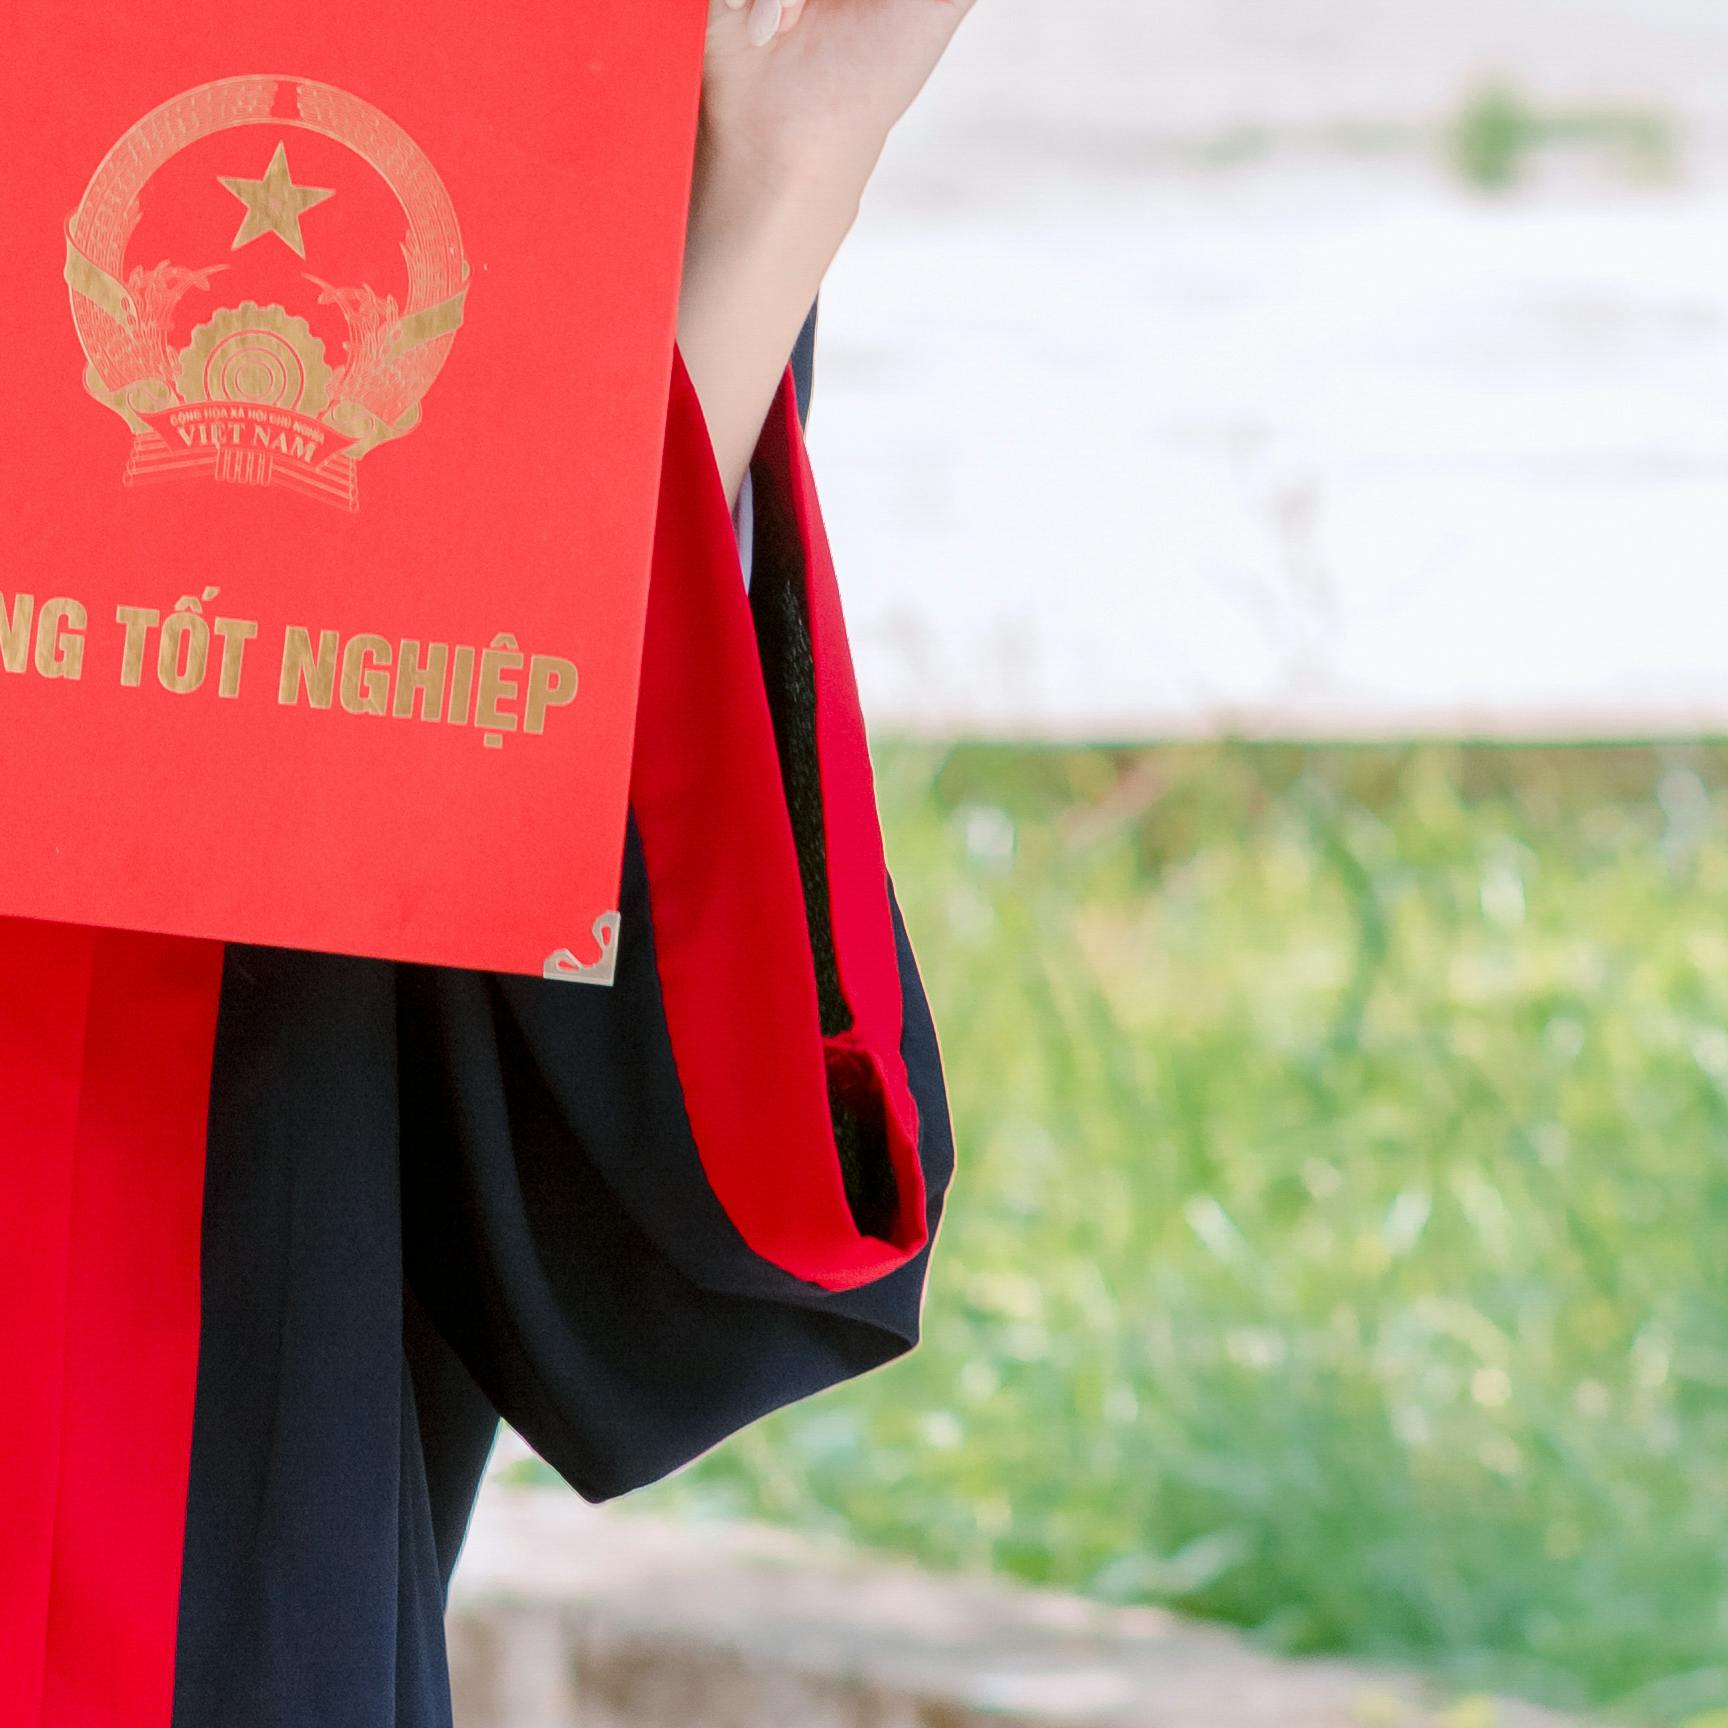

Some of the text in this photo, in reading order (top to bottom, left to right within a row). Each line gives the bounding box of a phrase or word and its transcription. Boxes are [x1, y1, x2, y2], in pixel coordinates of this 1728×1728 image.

[253, 424, 316, 463] NAM
[116, 586, 258, 698] TỐT
[278, 625, 579, 749] NGHIỆP
